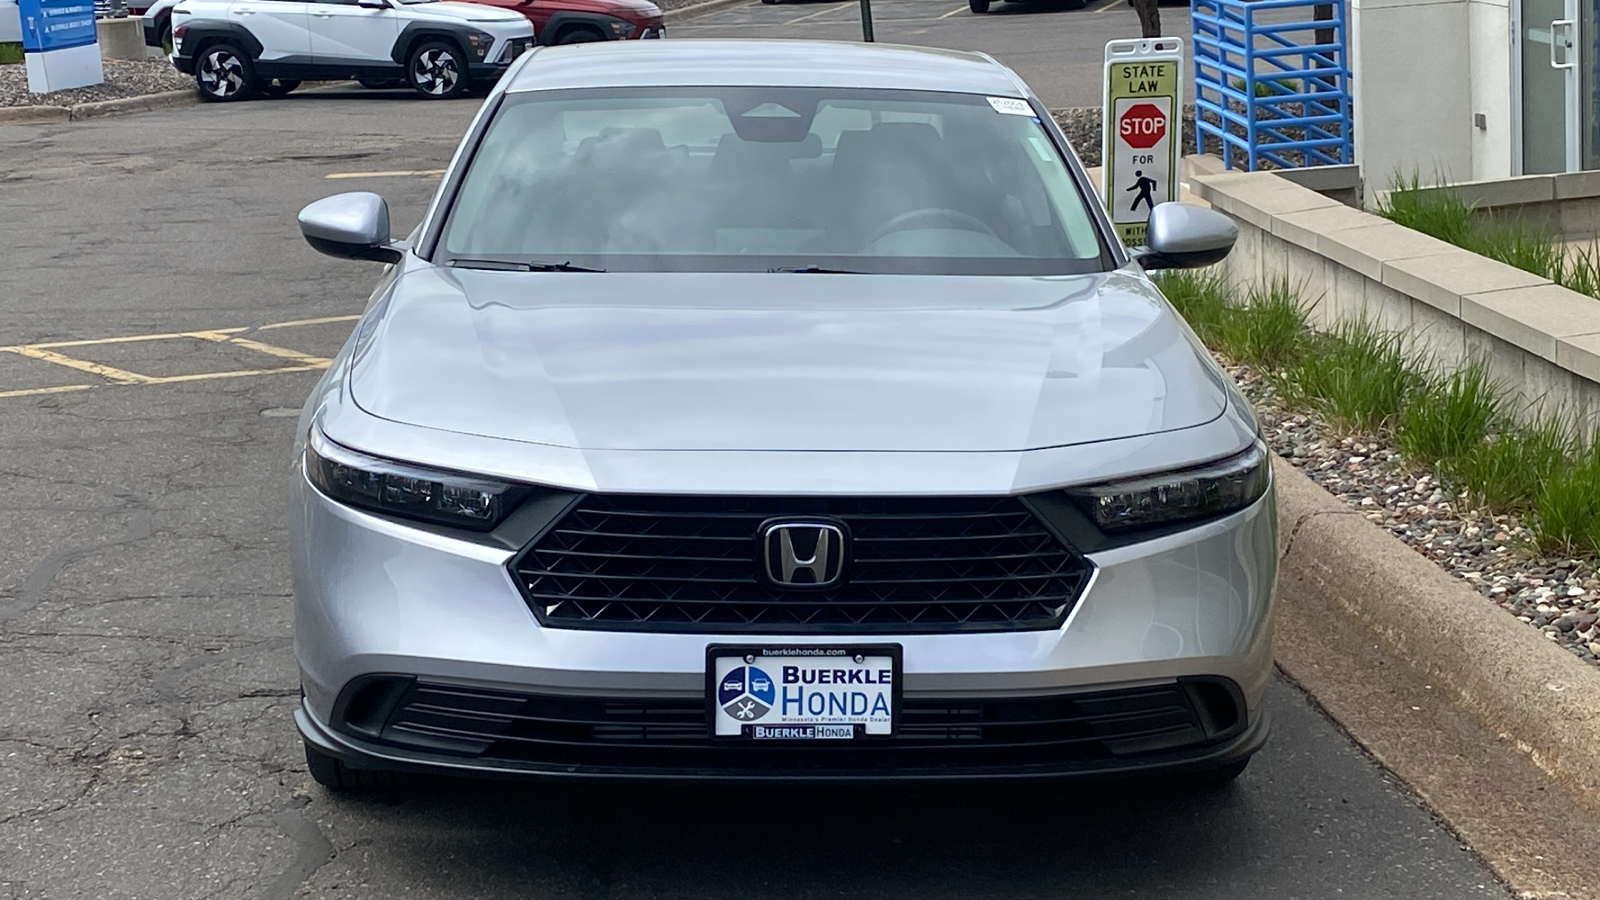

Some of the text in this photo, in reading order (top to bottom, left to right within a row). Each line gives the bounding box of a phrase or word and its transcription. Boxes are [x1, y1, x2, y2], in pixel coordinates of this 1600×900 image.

[1123, 65, 1165, 79] STATE
[1129, 80, 1158, 93] LAW
[1121, 117, 1165, 135] STOP
[1132, 155, 1154, 165] FOR
[1125, 226, 1148, 236] WITH
[762, 648, 846, 656] buerklehonda.com
[782, 666, 891, 684] BUERKLE
[782, 686, 890, 716] HONDA
[755, 726, 852, 738] BUERKLE HONDA
